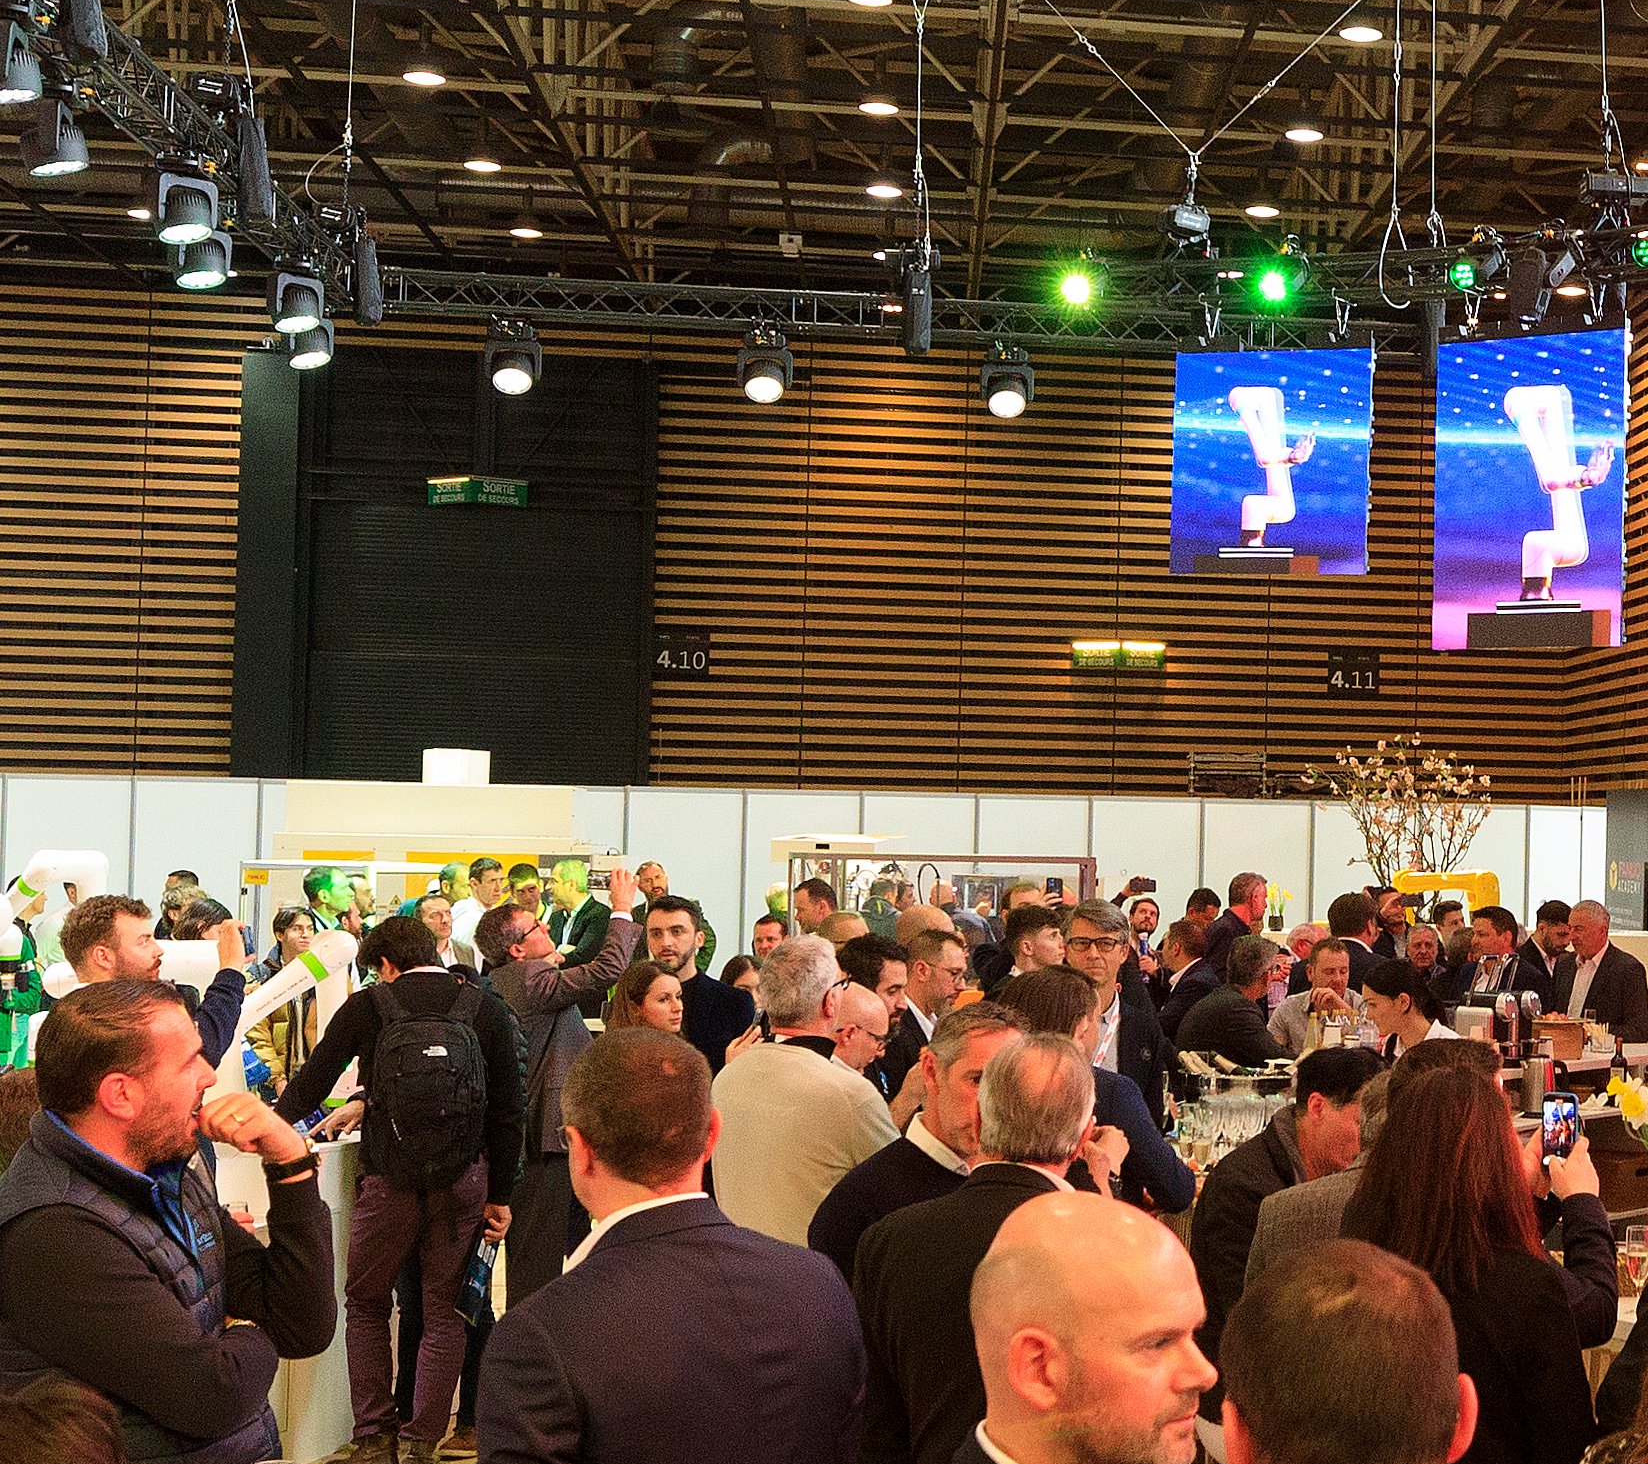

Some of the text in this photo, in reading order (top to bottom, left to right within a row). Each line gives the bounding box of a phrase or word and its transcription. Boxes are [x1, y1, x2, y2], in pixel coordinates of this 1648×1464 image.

[483, 481, 515, 495] SORTIE
[478, 494, 487, 502] DE
[657, 650, 705, 669] 4.10
[1331, 671, 1375, 689] 4.11
